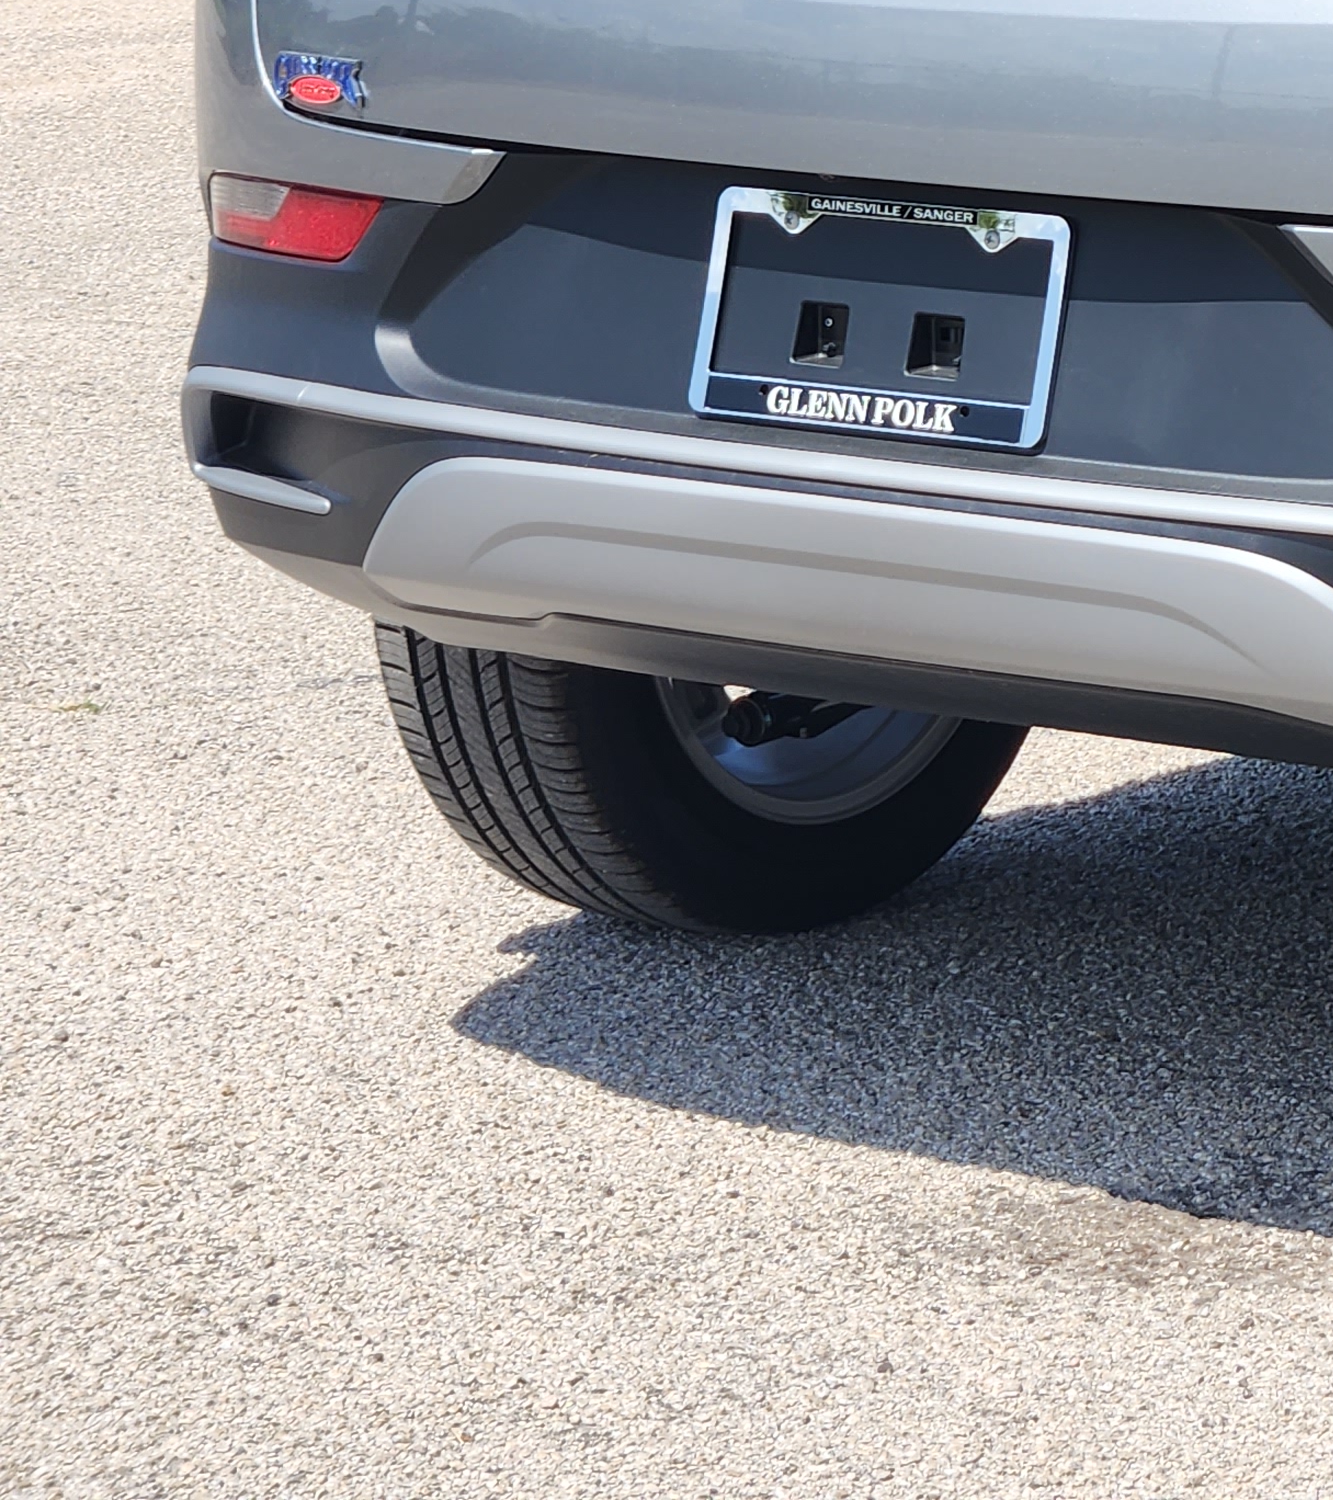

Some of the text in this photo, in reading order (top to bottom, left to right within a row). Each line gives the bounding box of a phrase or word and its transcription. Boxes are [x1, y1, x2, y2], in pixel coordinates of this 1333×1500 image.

[811, 198, 902, 217] GAINESVILLE
[913, 208, 974, 224] SANGER
[766, 385, 957, 433] GLENN POLK
